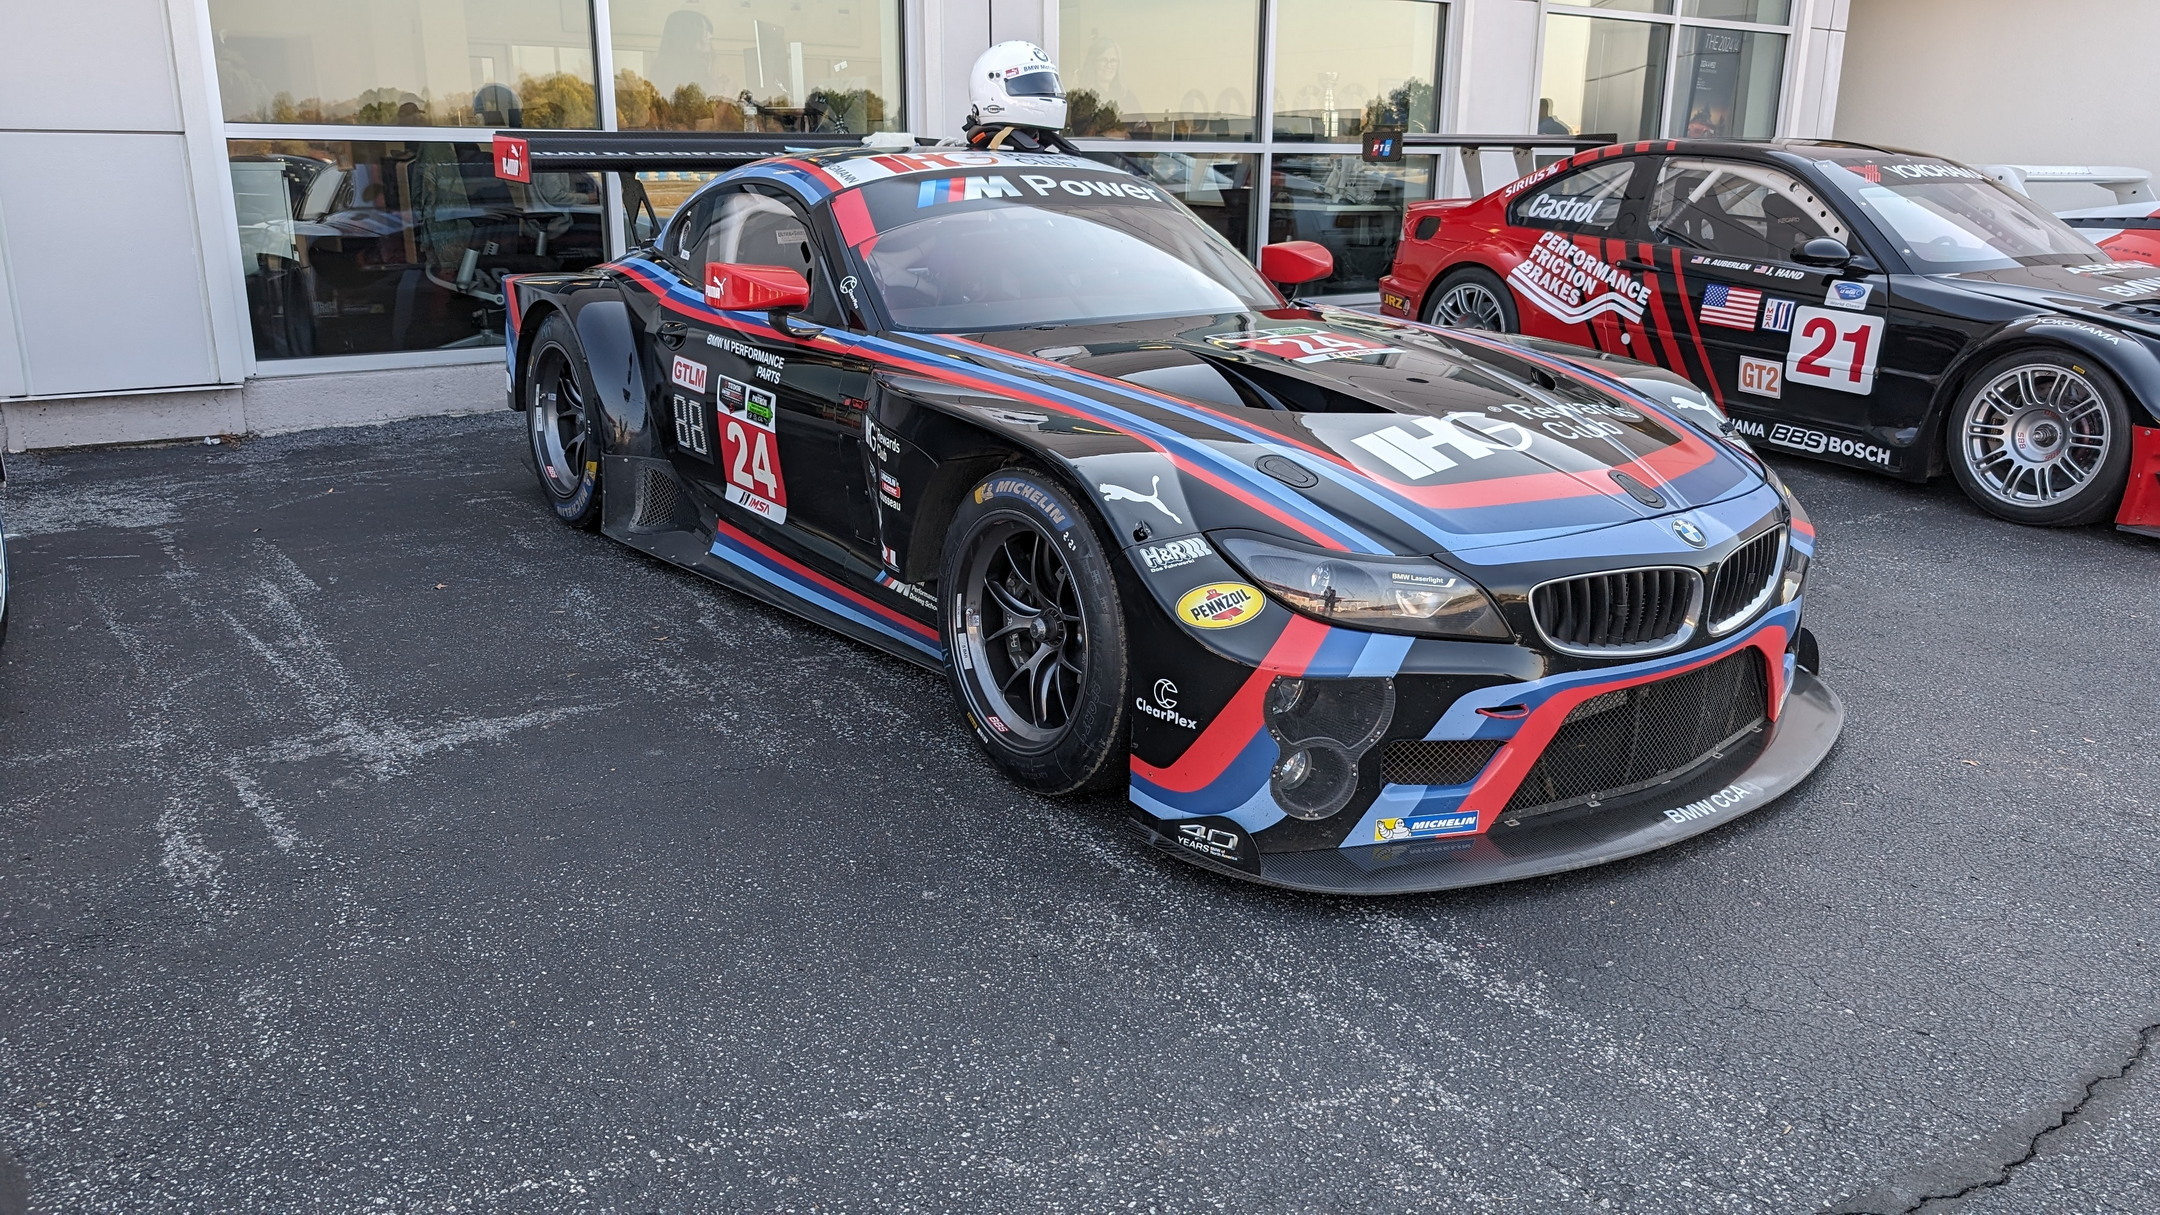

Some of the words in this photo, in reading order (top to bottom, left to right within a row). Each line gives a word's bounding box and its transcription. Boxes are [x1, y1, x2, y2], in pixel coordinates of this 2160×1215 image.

[1373, 143, 1391, 152] PTG
[1505, 172, 1545, 198] SIRIUS
[1883, 164, 1988, 181] YOKOHAMA
[1020, 175, 1163, 203] Power
[1529, 193, 1604, 224] Castrol
[1529, 245, 1598, 296] FRICTION
[1539, 231, 1652, 306] PERFORMANCE
[1711, 259, 1752, 271] AUBERLEN
[1765, 267, 1773, 277] J.
[1774, 268, 1805, 281] HAND
[705, 284, 721, 299] PUMA
[1519, 260, 1581, 306] BRAKES
[1383, 293, 1403, 310] JRZ
[1765, 301, 1774, 328] IMSA
[1268, 334, 1369, 354] 24
[2035, 318, 2120, 345] YOKOHAMA
[706, 333, 726, 349] BMW
[730, 342, 786, 370] PERFORMANCE
[1796, 317, 1872, 383] 21
[674, 360, 706, 389] GTLM
[756, 365, 782, 385] PARTS
[1742, 362, 1779, 392] GT2
[1502, 402, 1641, 421] Rewards
[877, 428, 901, 454] Rewards
[1541, 419, 1625, 440] Club
[1769, 423, 1827, 454] BBS
[1350, 410, 1534, 482] IHG
[1829, 436, 1891, 465] BOSCH
[727, 421, 778, 499] 24
[748, 497, 771, 516] IMSA
[996, 480, 1066, 524] MICHELIN
[1140, 539, 1200, 569] H&R
[1392, 573, 1410, 581] BMW
[1411, 574, 1444, 584] Laserlight
[909, 592, 926, 607] Driving
[1190, 588, 1251, 621] PENNZOIL
[988, 715, 1008, 733] BBS
[1136, 697, 1198, 730] ClearPlex
[1663, 799, 1717, 824] BMW
[1710, 784, 1751, 808] CCA
[1411, 816, 1477, 831] MICHELIN
[1177, 835, 1211, 853] YEARS
[1179, 824, 1239, 851] 40
